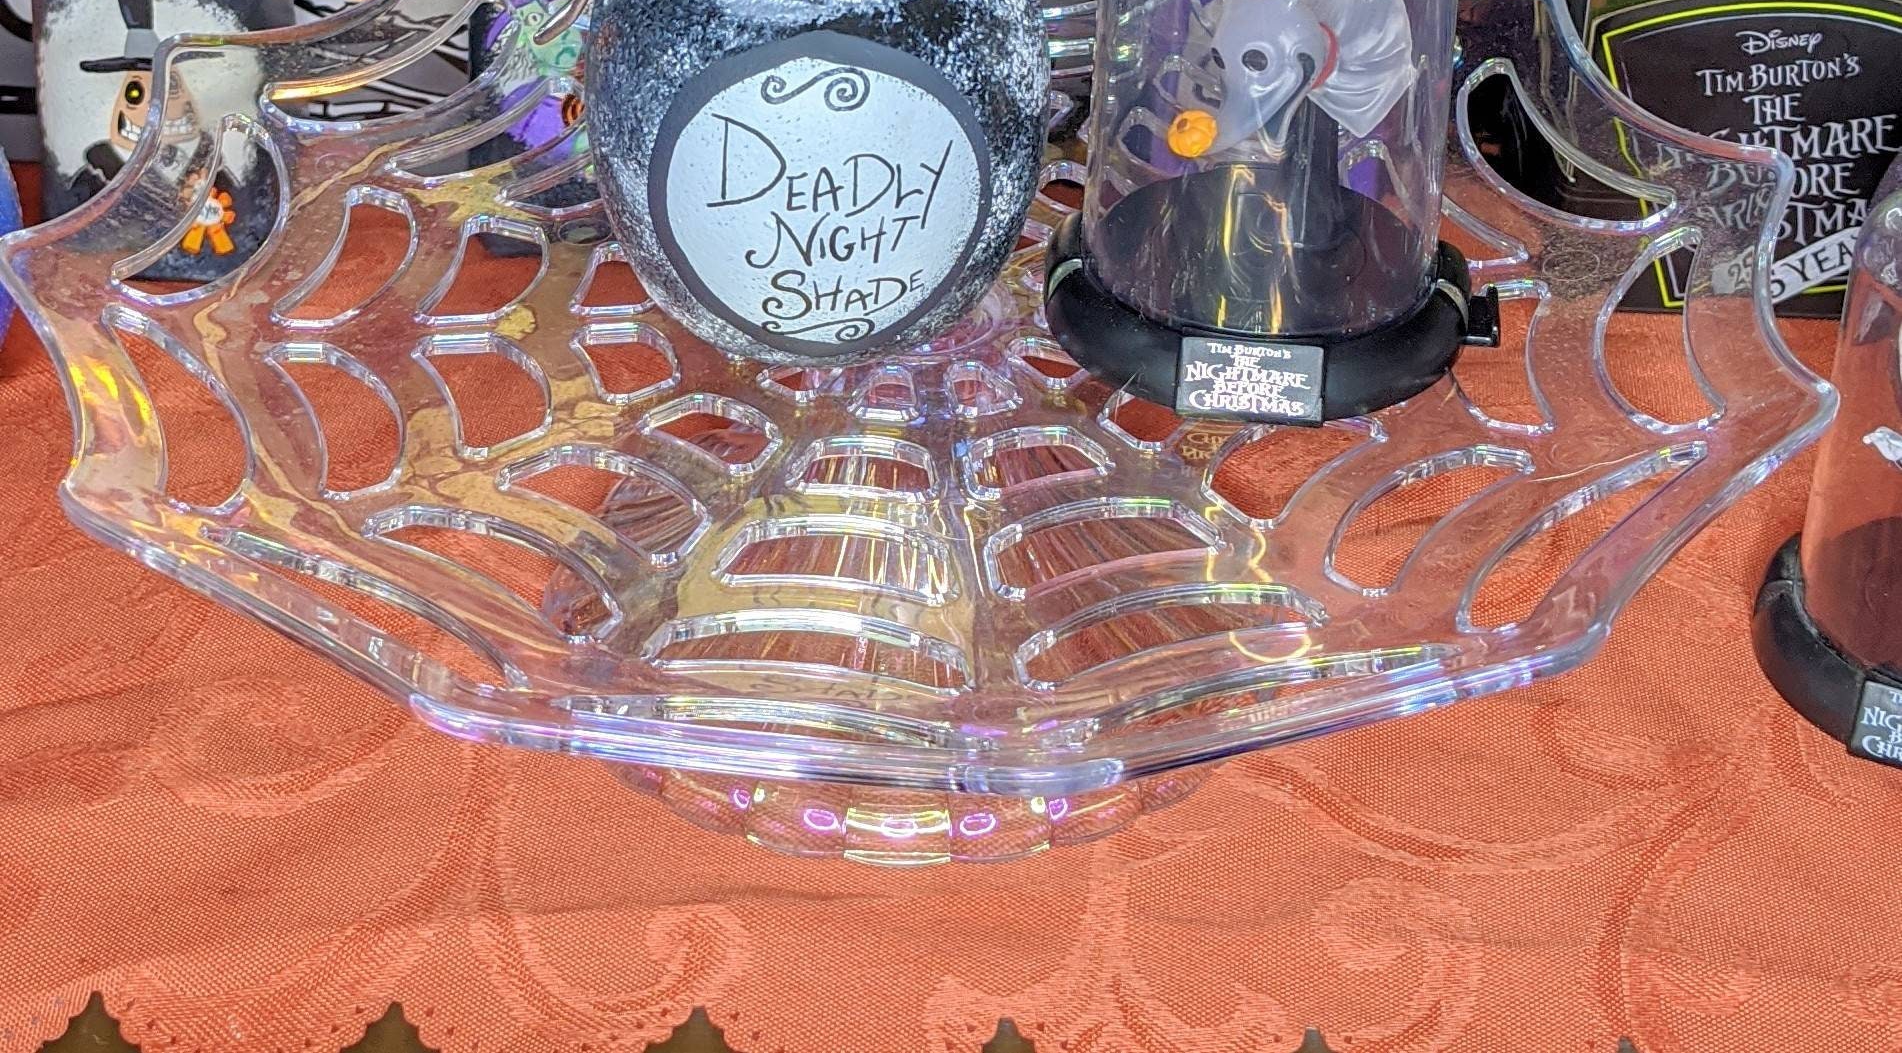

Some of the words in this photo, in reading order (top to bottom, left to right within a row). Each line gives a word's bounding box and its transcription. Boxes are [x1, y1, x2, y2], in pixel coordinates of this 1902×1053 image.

[1695, 68, 1745, 96] TIM
[1747, 53, 1862, 93] BURTON'S
[1742, 93, 1806, 125] THE
[706, 112, 954, 230] DEADLY
[744, 210, 922, 269] NIGHT
[1780, 234, 1858, 283] YEA
[761, 268, 925, 321] SHADE
[1206, 342, 1232, 354] TIM
[1230, 354, 1261, 369] THE
[1184, 360, 1311, 390] NIGHTMARE
[1212, 379, 1288, 400] BEFORE
[1188, 389, 1306, 417] CHRISTMAS
